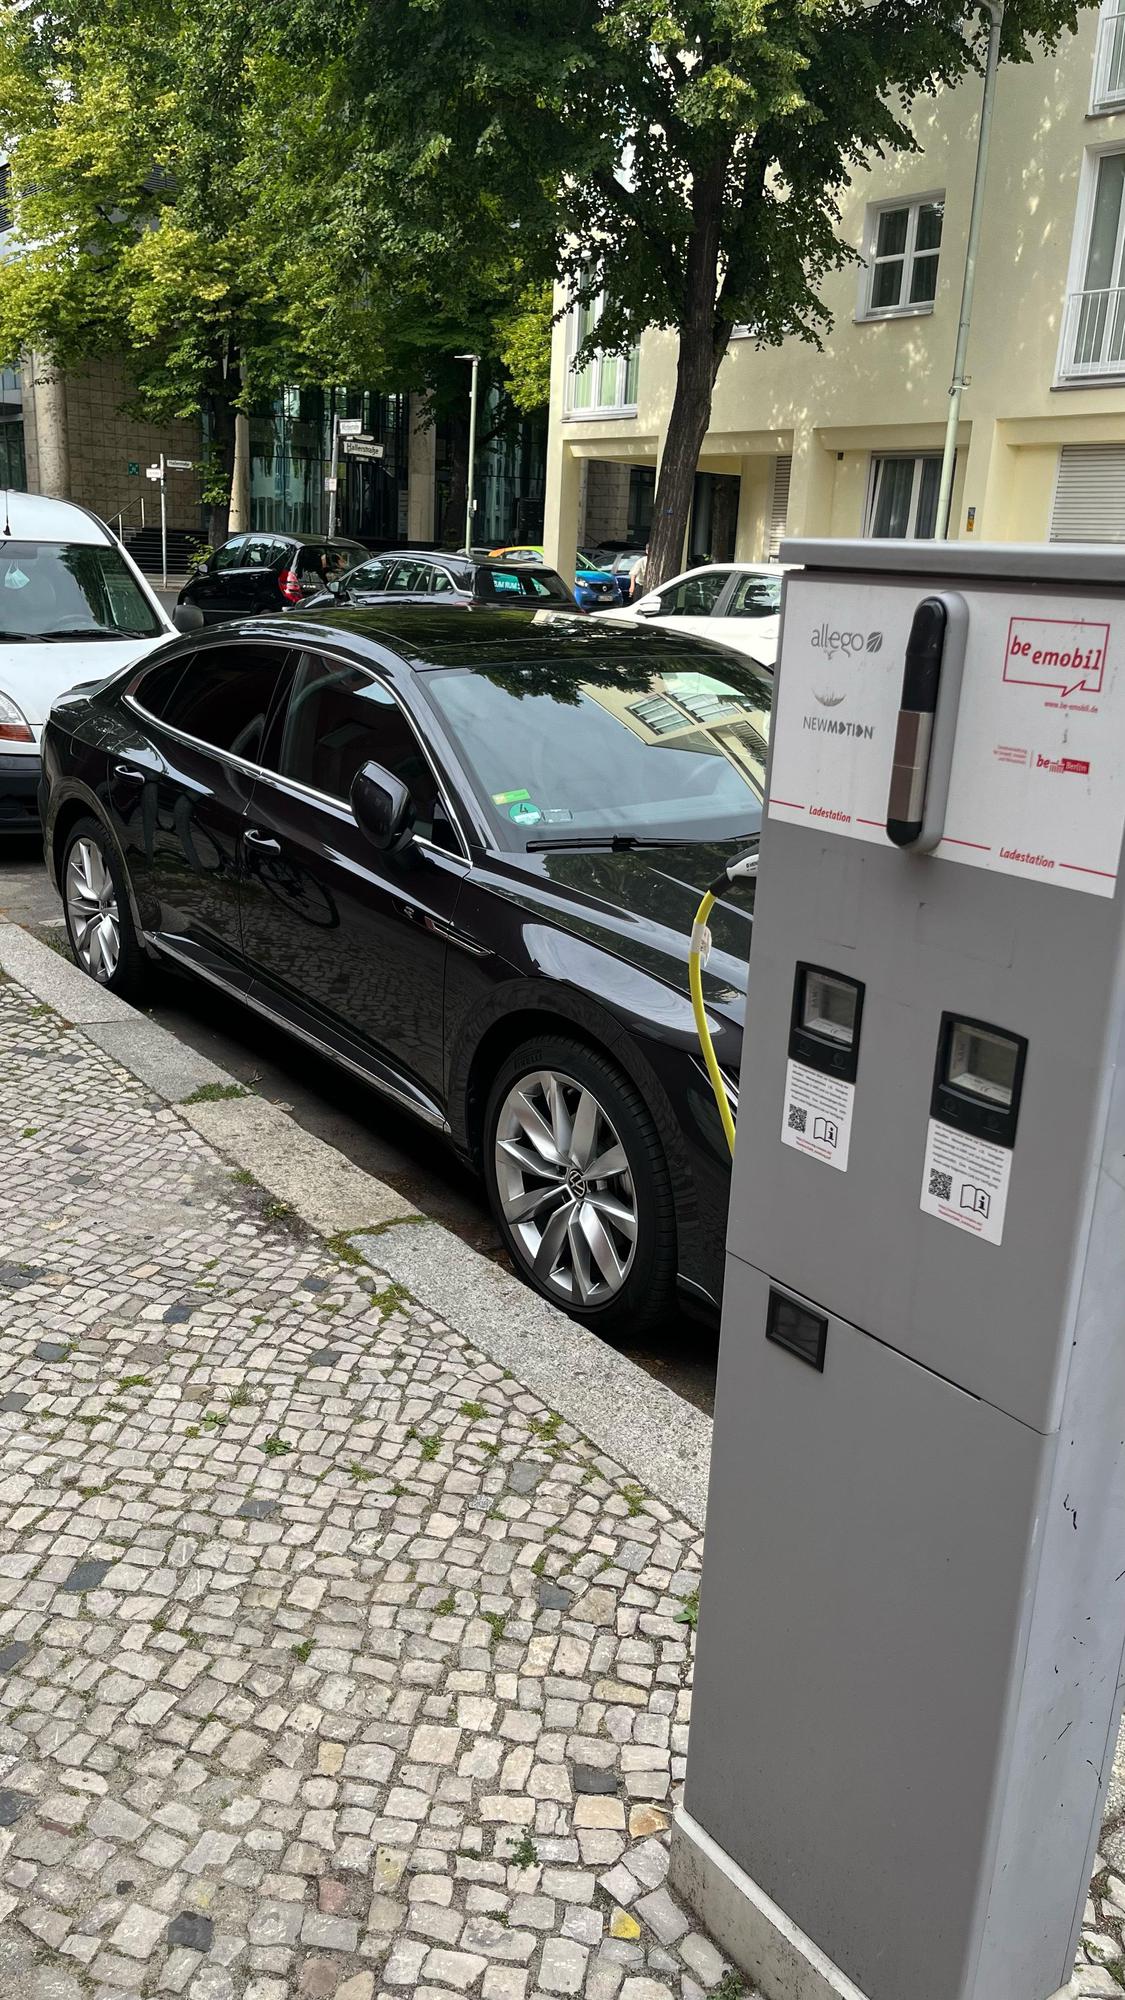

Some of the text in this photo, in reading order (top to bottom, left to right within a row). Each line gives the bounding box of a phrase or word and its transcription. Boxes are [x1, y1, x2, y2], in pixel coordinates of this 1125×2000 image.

[811, 623, 864, 660] allego
[1010, 634, 1102, 670] be emobil
[803, 715, 874, 739] NEWMOTION
[809, 804, 852, 823] Ladestation
[1000, 847, 1055, 869] Ladestation
